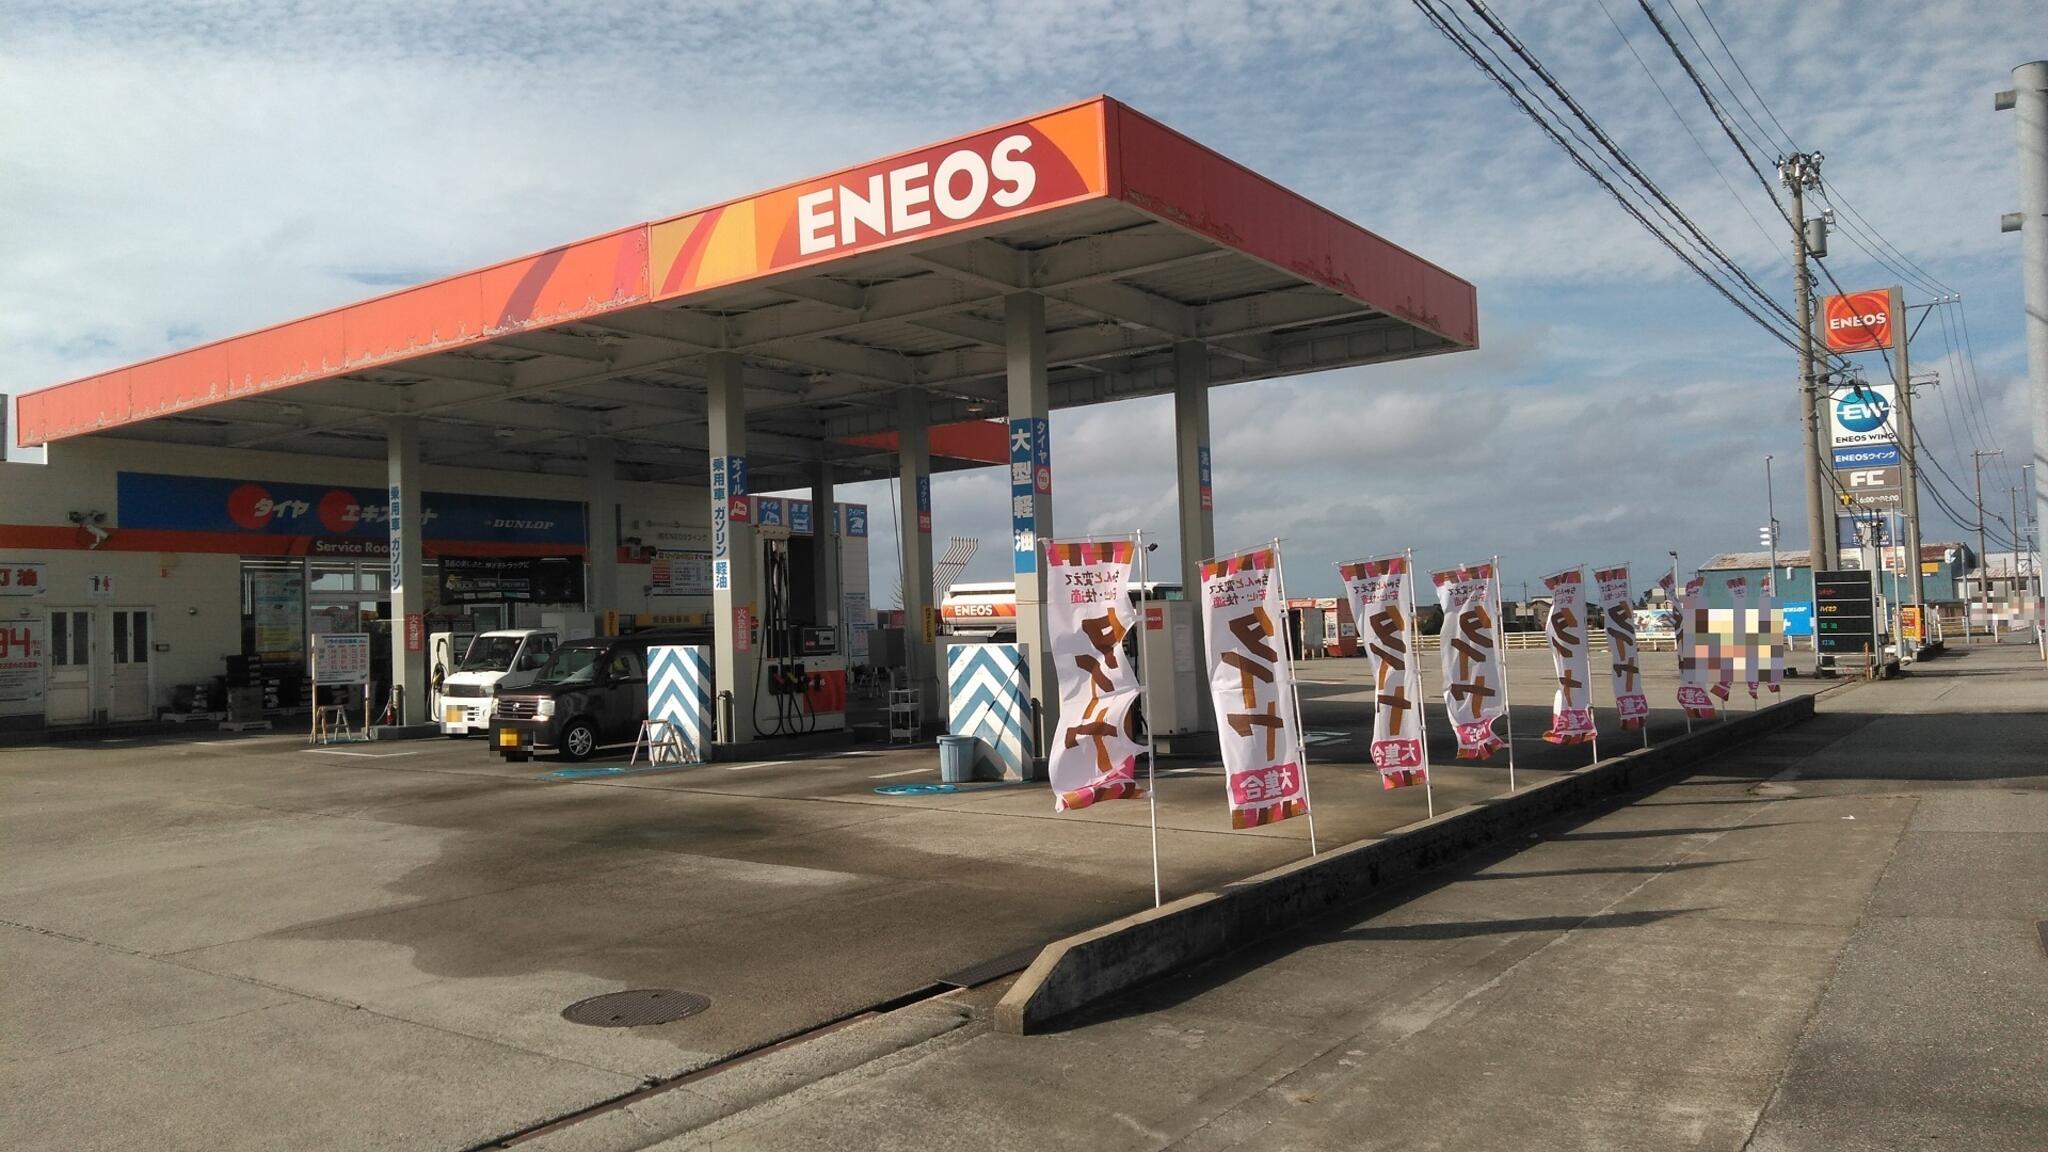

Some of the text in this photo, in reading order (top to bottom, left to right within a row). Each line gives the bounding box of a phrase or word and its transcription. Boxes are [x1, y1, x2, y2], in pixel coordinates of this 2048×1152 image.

[798, 135, 1036, 255] ENEOS
[1830, 312, 1886, 329] ENEOS
[1037, 421, 1048, 464] タイヤ
[1836, 432, 1895, 444] ENEOS WING
[1835, 451, 1896, 463] ENEOSウイング
[731, 458, 744, 495] オイル
[1851, 470, 1884, 486] FC
[1011, 428, 1034, 551] 大型軽油
[254, 498, 310, 518] タイヤ
[341, 504, 438, 525] エキスト
[493, 519, 555, 530] DUNLOP
[713, 458, 728, 589] 乗用車 ガソリン 軽油
[316, 541, 390, 553] Service Roo
[390, 485, 401, 590] 乗用車 ガソリン
[955, 604, 993, 616] ENEOS
